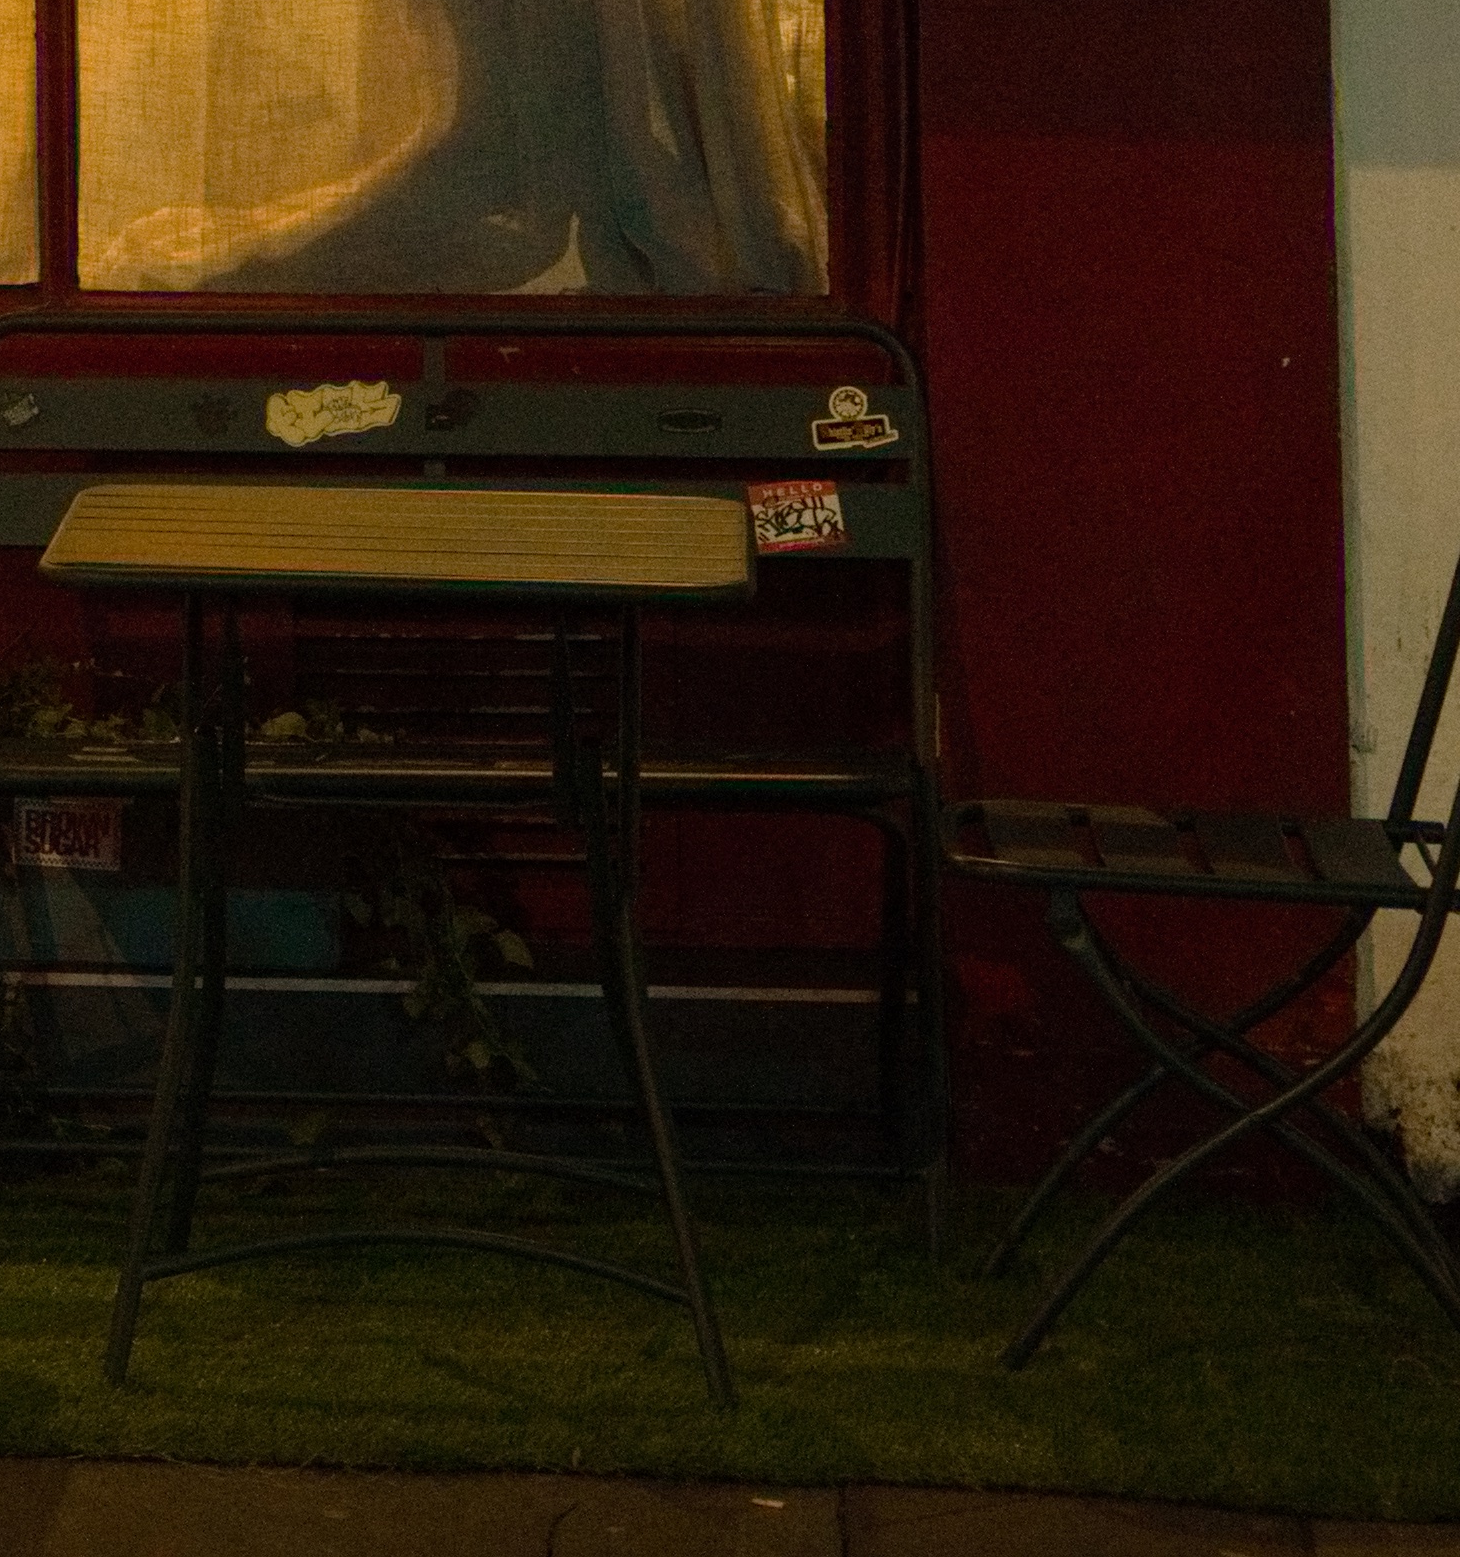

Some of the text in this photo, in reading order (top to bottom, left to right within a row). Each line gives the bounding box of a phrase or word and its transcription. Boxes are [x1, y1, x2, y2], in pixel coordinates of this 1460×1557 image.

[762, 483, 823, 498] HELLO
[25, 809, 112, 837] BROWN
[24, 831, 100, 858] SUGAR
